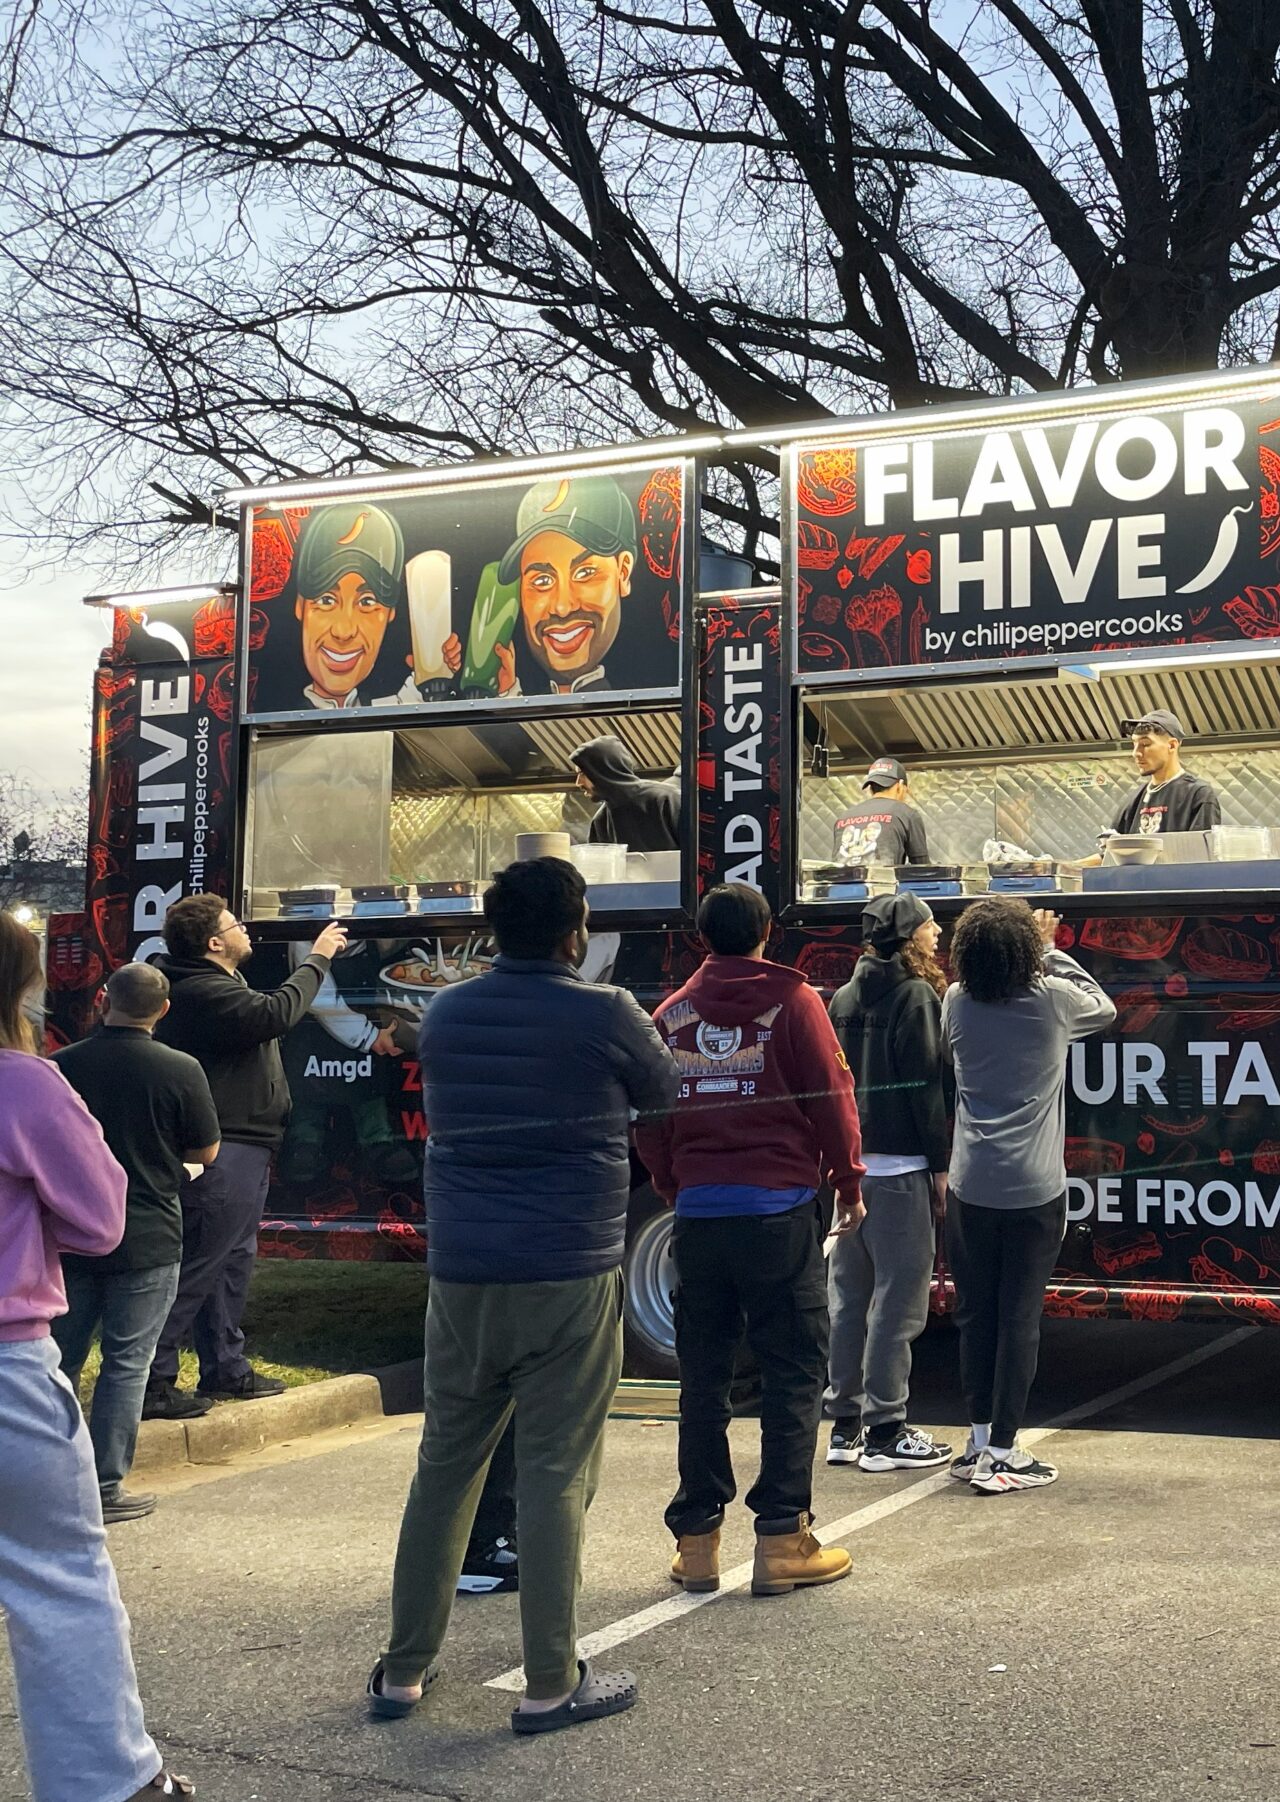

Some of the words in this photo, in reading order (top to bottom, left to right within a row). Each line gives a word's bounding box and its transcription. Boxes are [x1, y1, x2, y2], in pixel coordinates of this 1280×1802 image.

[863, 407, 1250, 527] FLAVOR
[939, 513, 1167, 614] HIVE
[924, 626, 956, 654] by
[961, 611, 1184, 648] chilipeppercooks
[724, 643, 763, 802] TASTE
[135, 675, 190, 860] HIVE
[837, 816, 868, 829] FLAVOR
[869, 814, 893, 823] HIVE
[724, 814, 763, 893] AD
[304, 1055, 372, 1083] Amgd
[741, 1080, 756, 1095] 32
[1071, 1042, 1169, 1105] UR
[1066, 1177, 1123, 1223] DE
